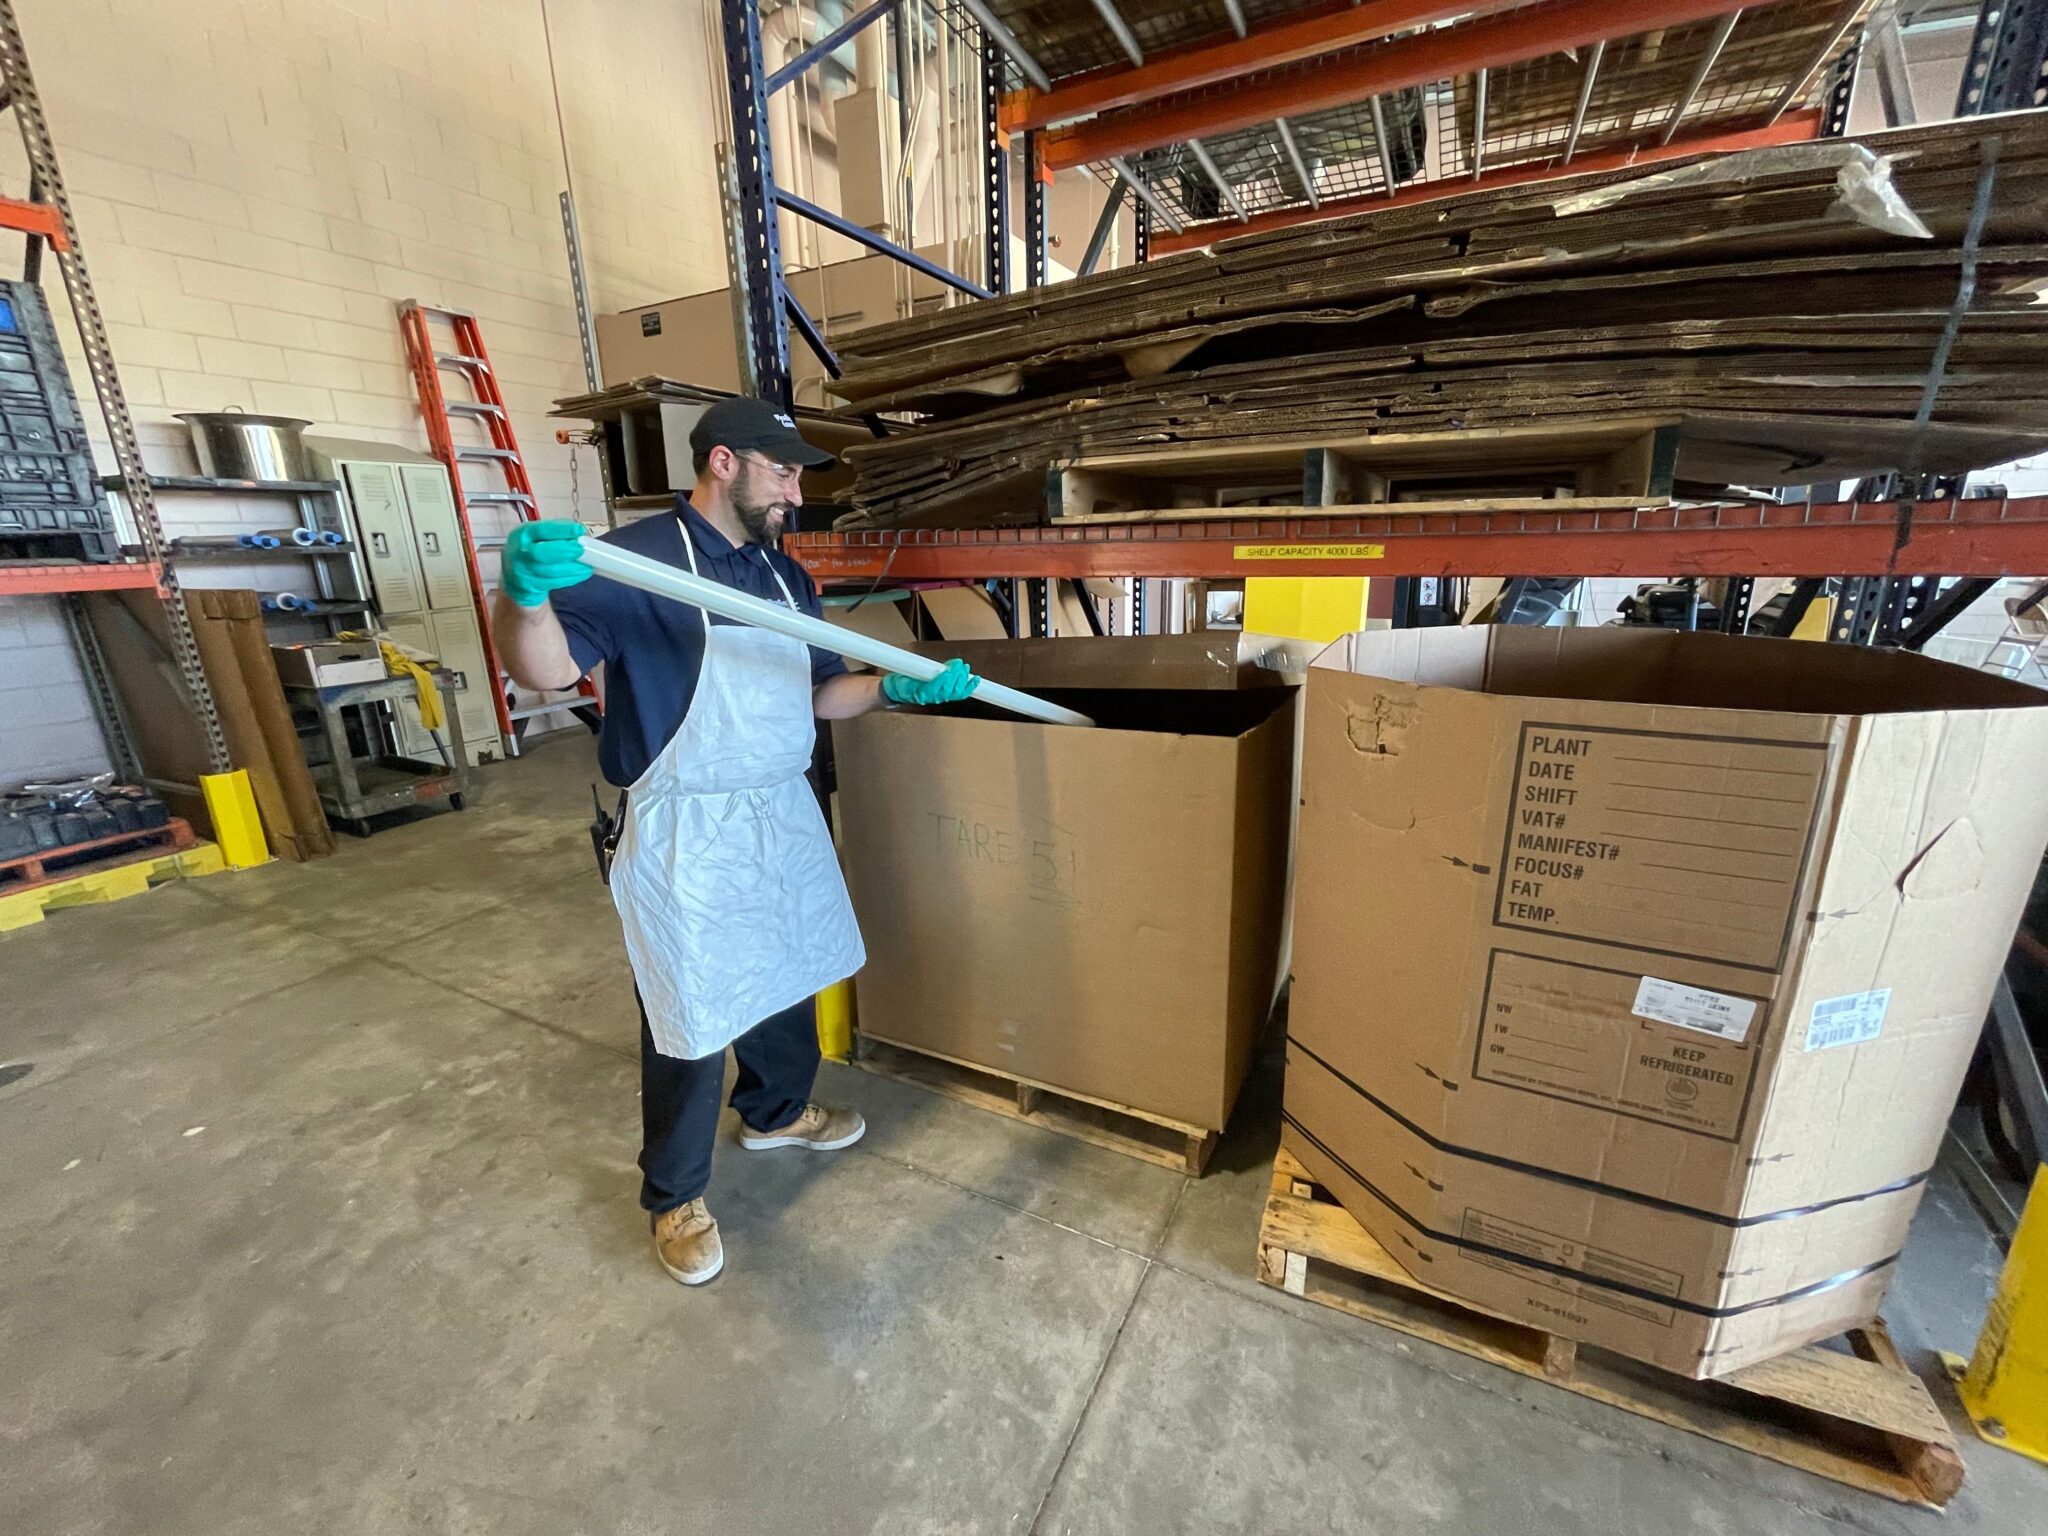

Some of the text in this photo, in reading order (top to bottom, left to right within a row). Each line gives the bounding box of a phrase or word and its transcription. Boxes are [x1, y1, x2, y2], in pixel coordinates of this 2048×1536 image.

[1247, 546, 1369, 557] SHELF CAPACITY 4000 LBS
[1532, 735, 1592, 757] PLANT
[1528, 761, 1575, 781] DATE
[1524, 785, 1578, 806] SHIFT
[1521, 809, 1566, 829] VAT#
[926, 812, 1019, 865] TARE
[1517, 833, 1620, 861] MANIFEST#
[1514, 856, 1584, 881] FOCUS#
[1510, 880, 1543, 898] FAT
[1507, 901, 1560, 925] TEMP.
[1496, 1003, 1513, 1014] NW
[1494, 1024, 1509, 1034] TW
[1490, 1043, 1505, 1055] GW
[1672, 1046, 1706, 1062] KEEP
[1640, 1055, 1734, 1086] REFRIGERATED
